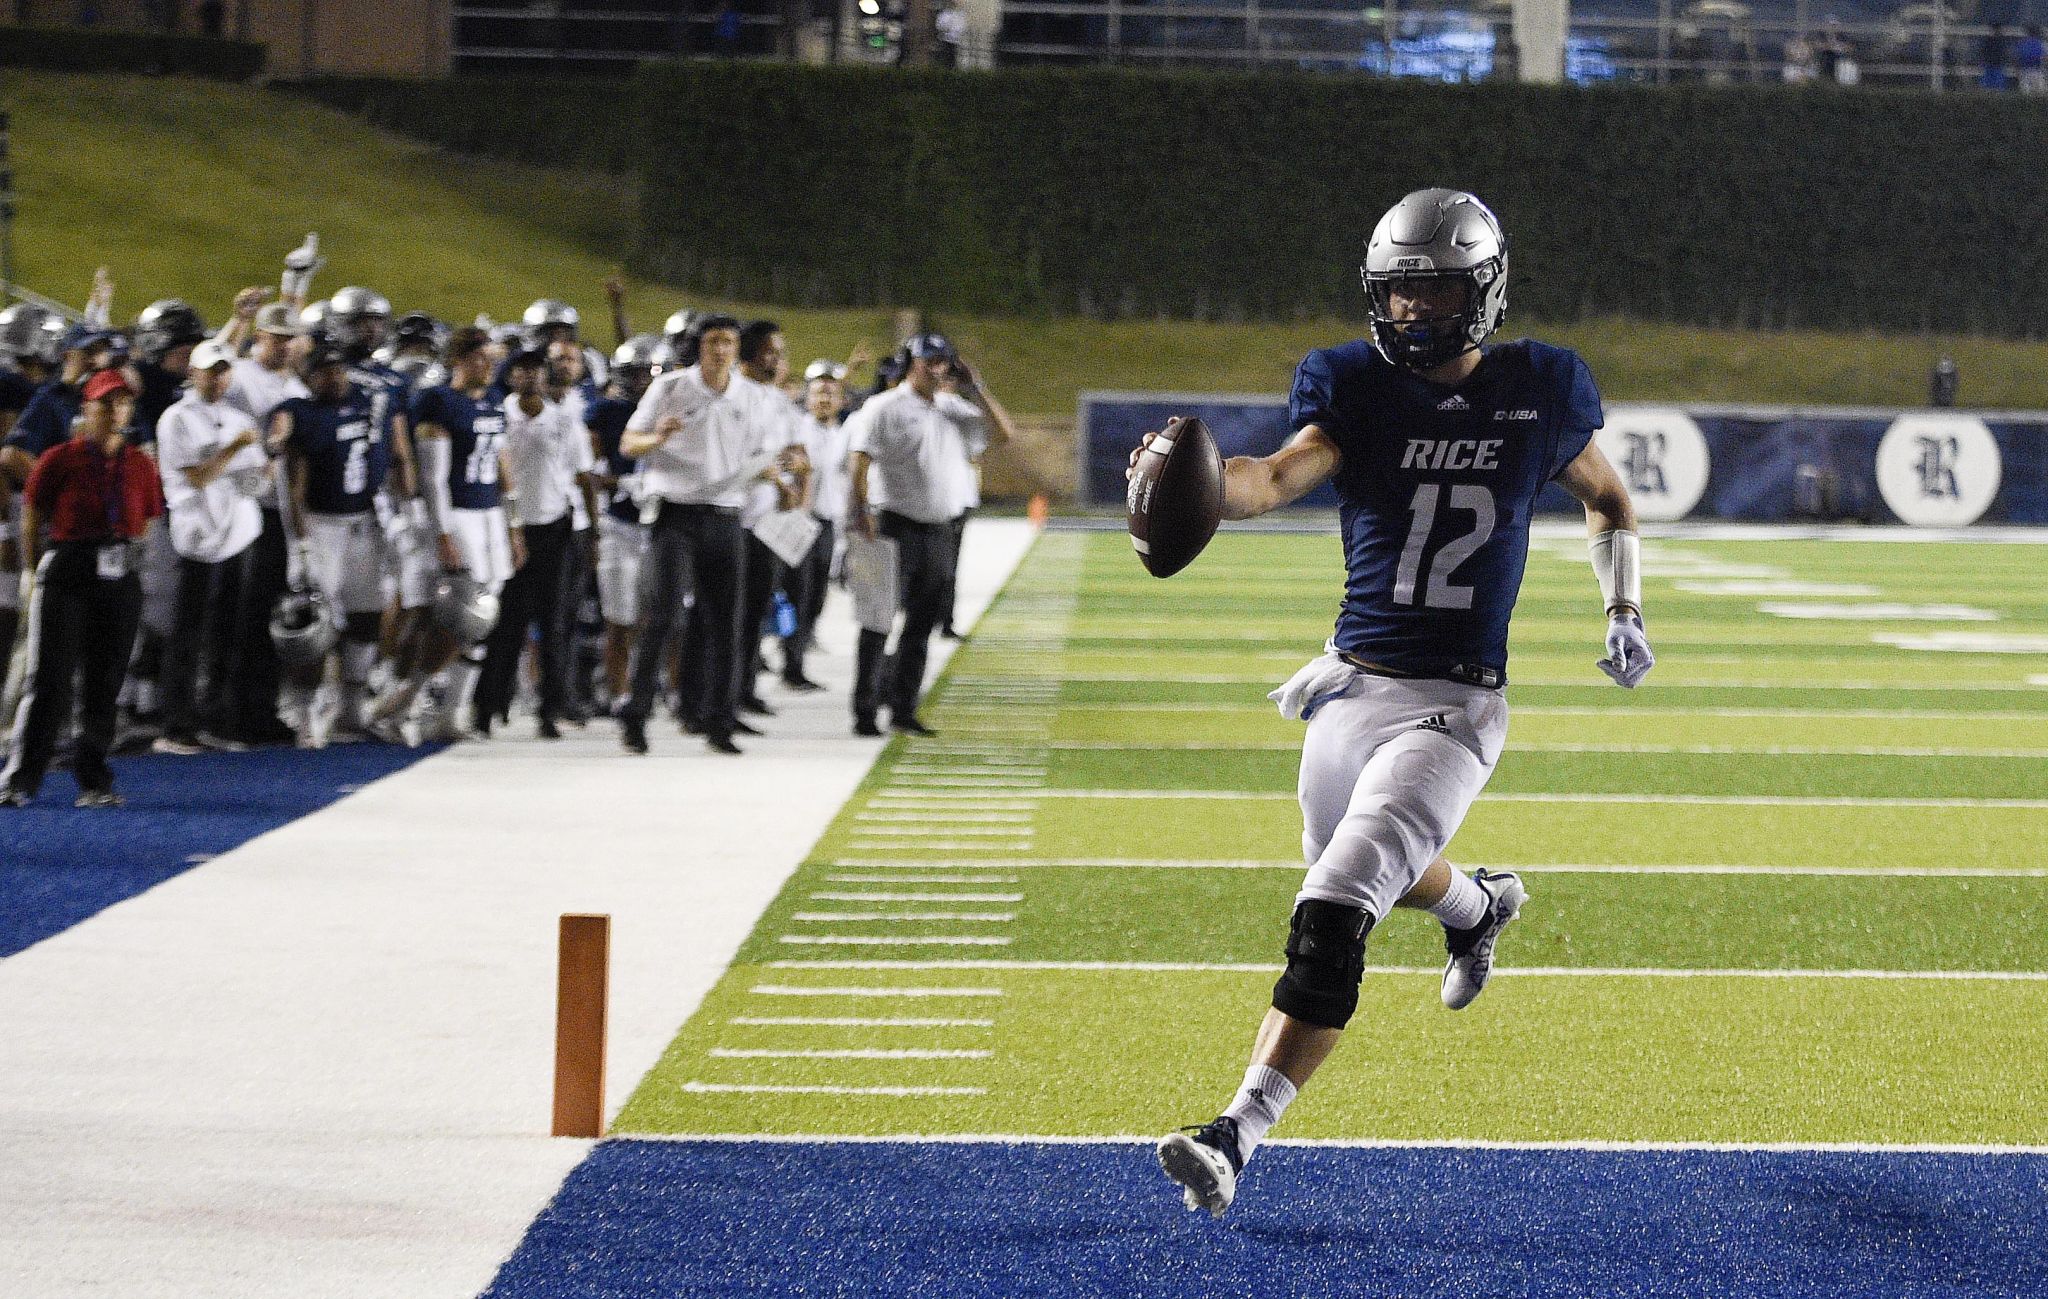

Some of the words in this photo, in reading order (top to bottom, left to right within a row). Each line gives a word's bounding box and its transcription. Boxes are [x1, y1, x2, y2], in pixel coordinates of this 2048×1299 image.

[1397, 258, 1422, 268] RICE
[1400, 439, 1504, 470] RICE
[1393, 483, 1496, 609] 12
